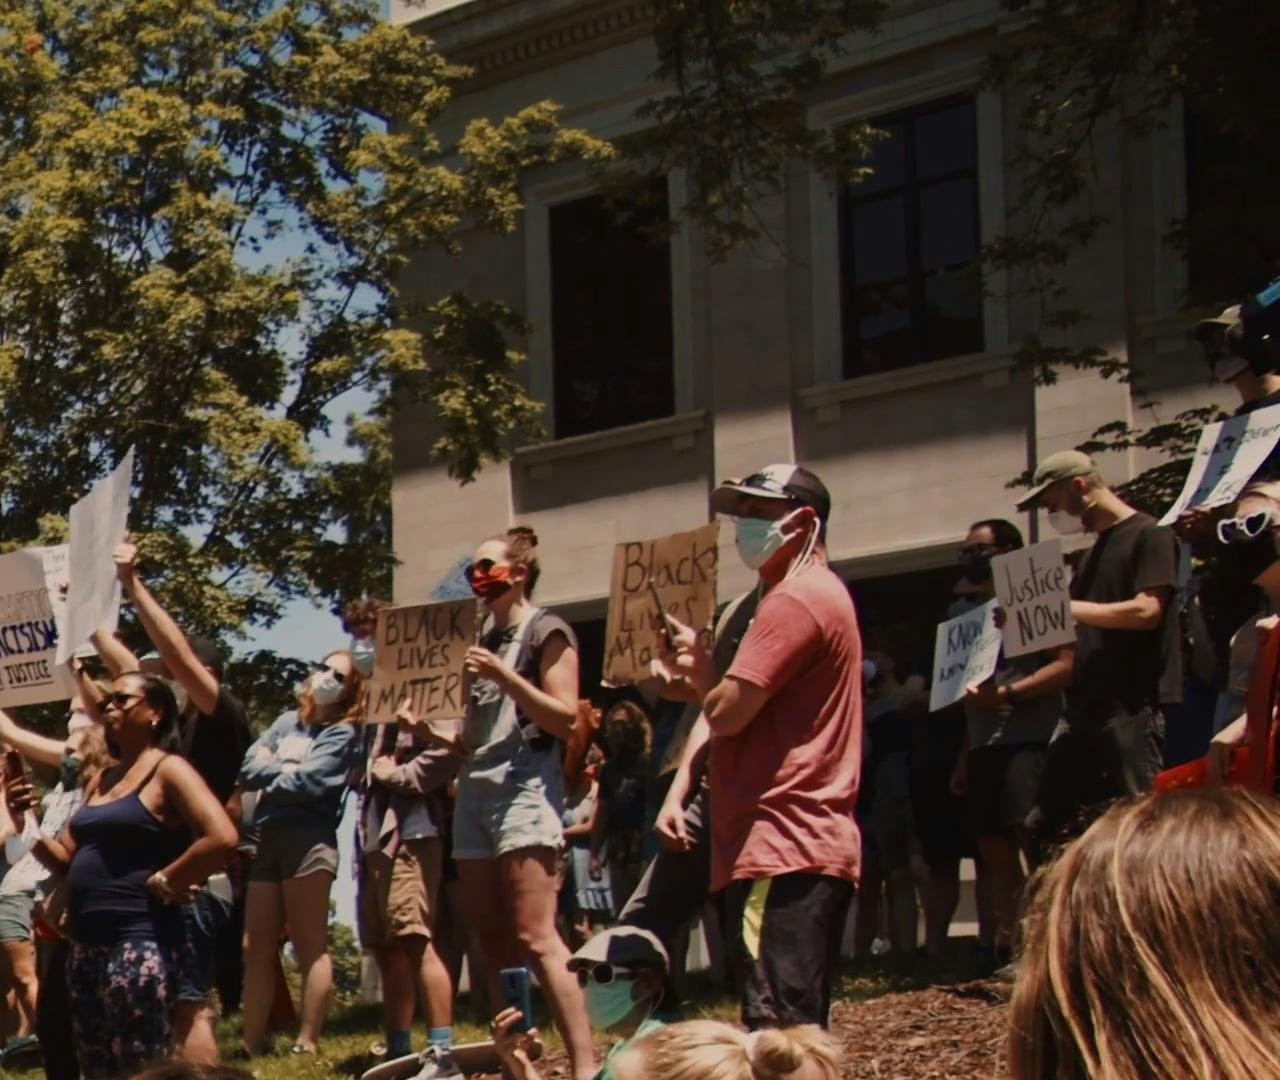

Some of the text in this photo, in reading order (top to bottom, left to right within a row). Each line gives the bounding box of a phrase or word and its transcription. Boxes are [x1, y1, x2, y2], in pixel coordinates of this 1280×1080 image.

[1004, 557, 1065, 607] Justice
[385, 608, 466, 646] BLACK
[1016, 601, 1066, 647] NOW
[5, 659, 52, 684] JUSTICE
[397, 644, 450, 671] LIVES
[374, 675, 461, 714] MATTER
